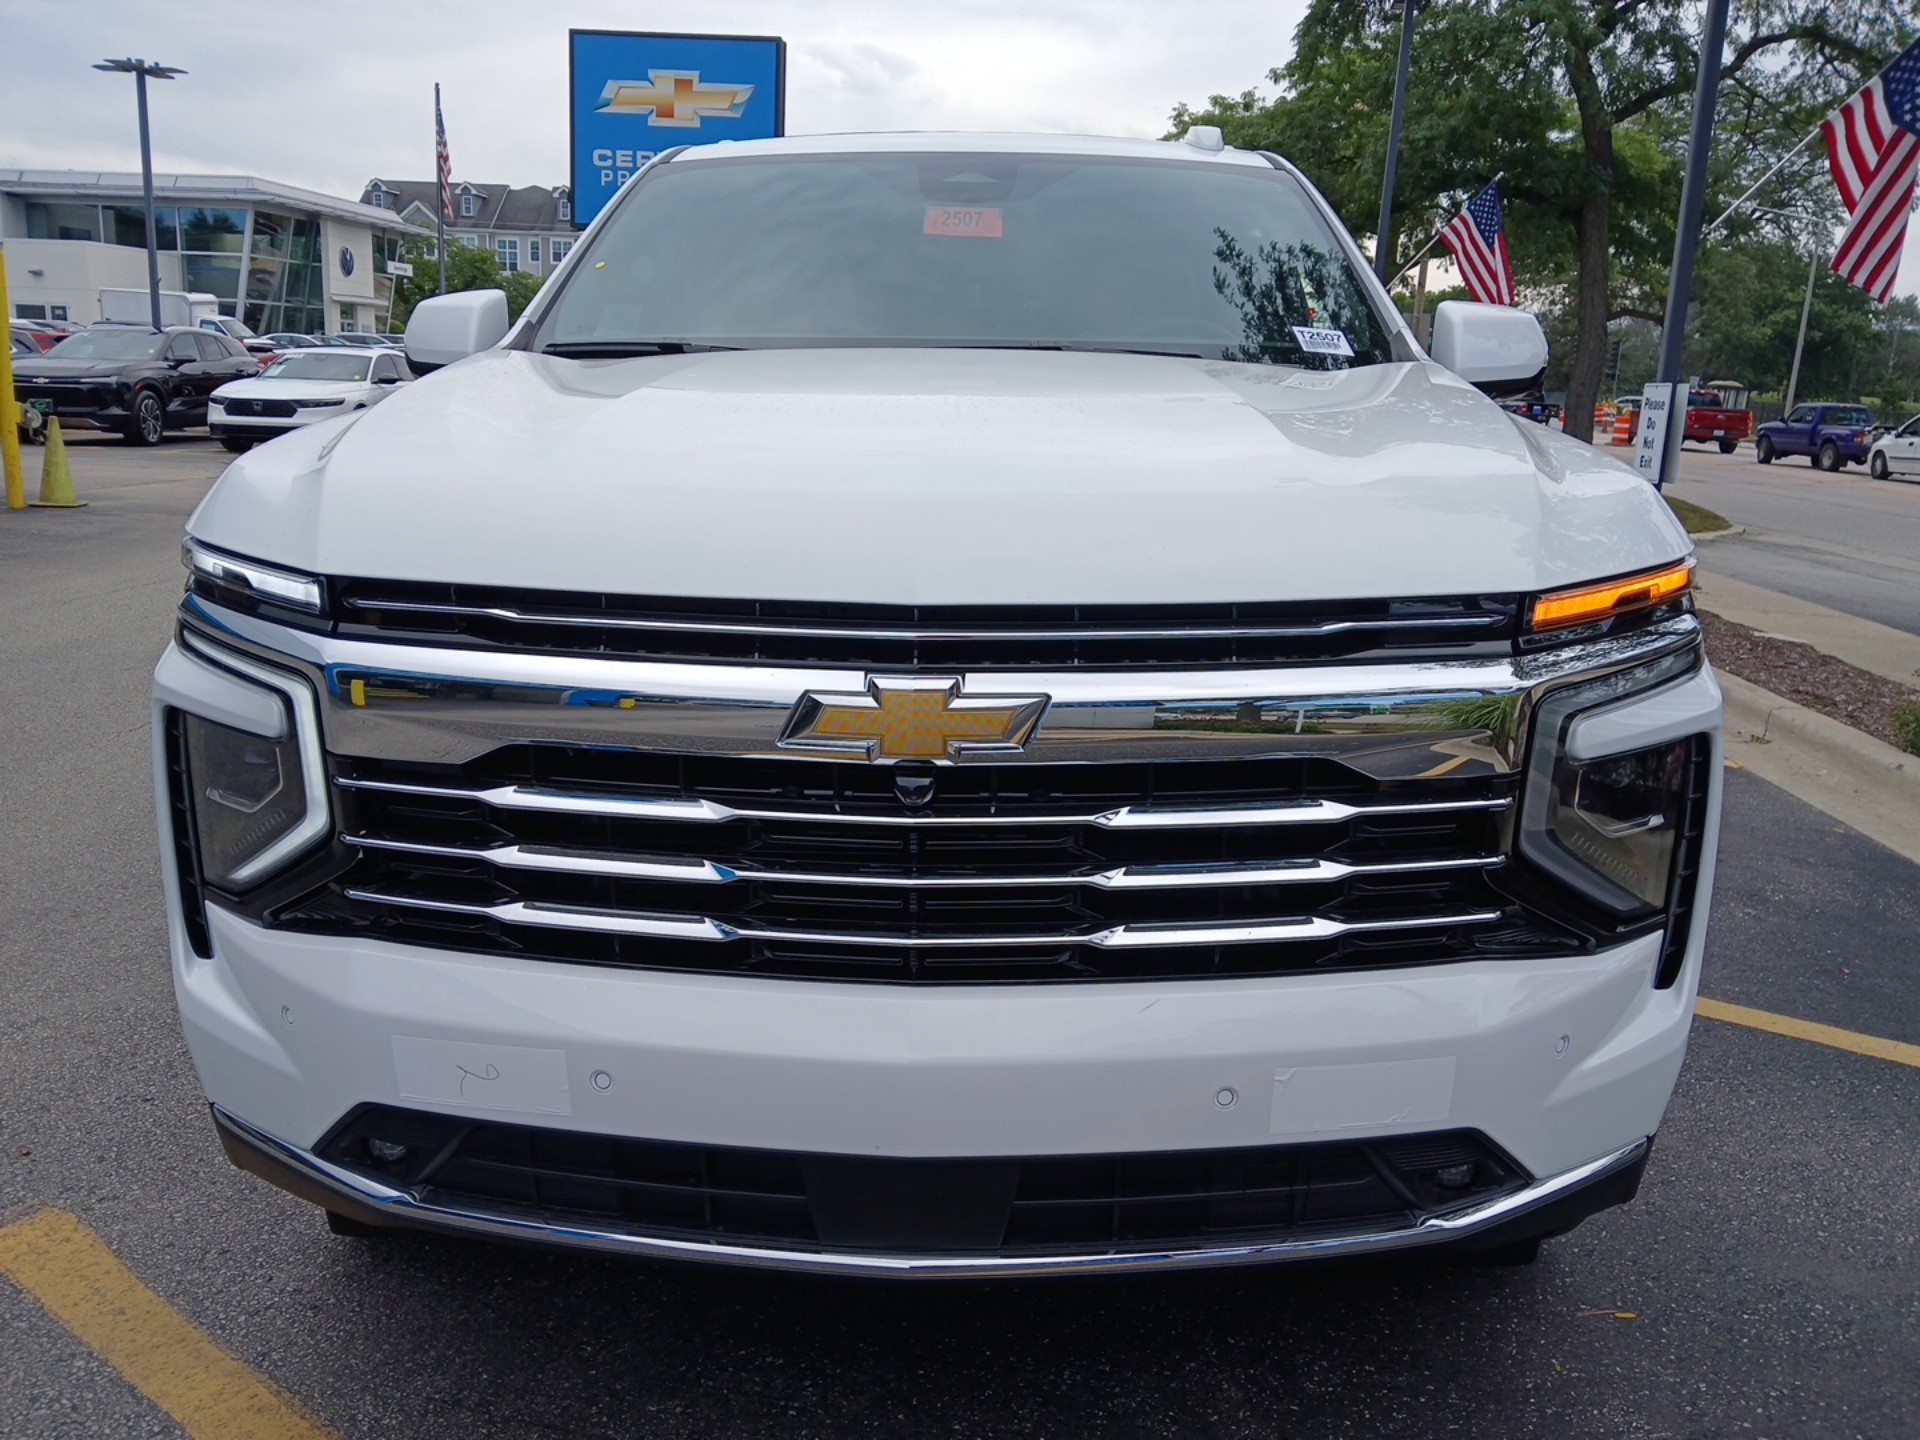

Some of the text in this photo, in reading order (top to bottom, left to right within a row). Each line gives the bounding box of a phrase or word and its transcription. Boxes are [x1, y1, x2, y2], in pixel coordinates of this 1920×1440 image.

[592, 149, 661, 168] CER
[942, 211, 983, 227] 2507
[1297, 330, 1341, 342] T2507
[1644, 397, 1665, 411] Please
[1647, 417, 1656, 430] Do
[1643, 436, 1655, 450] Not
[1640, 455, 1653, 469] Exit
